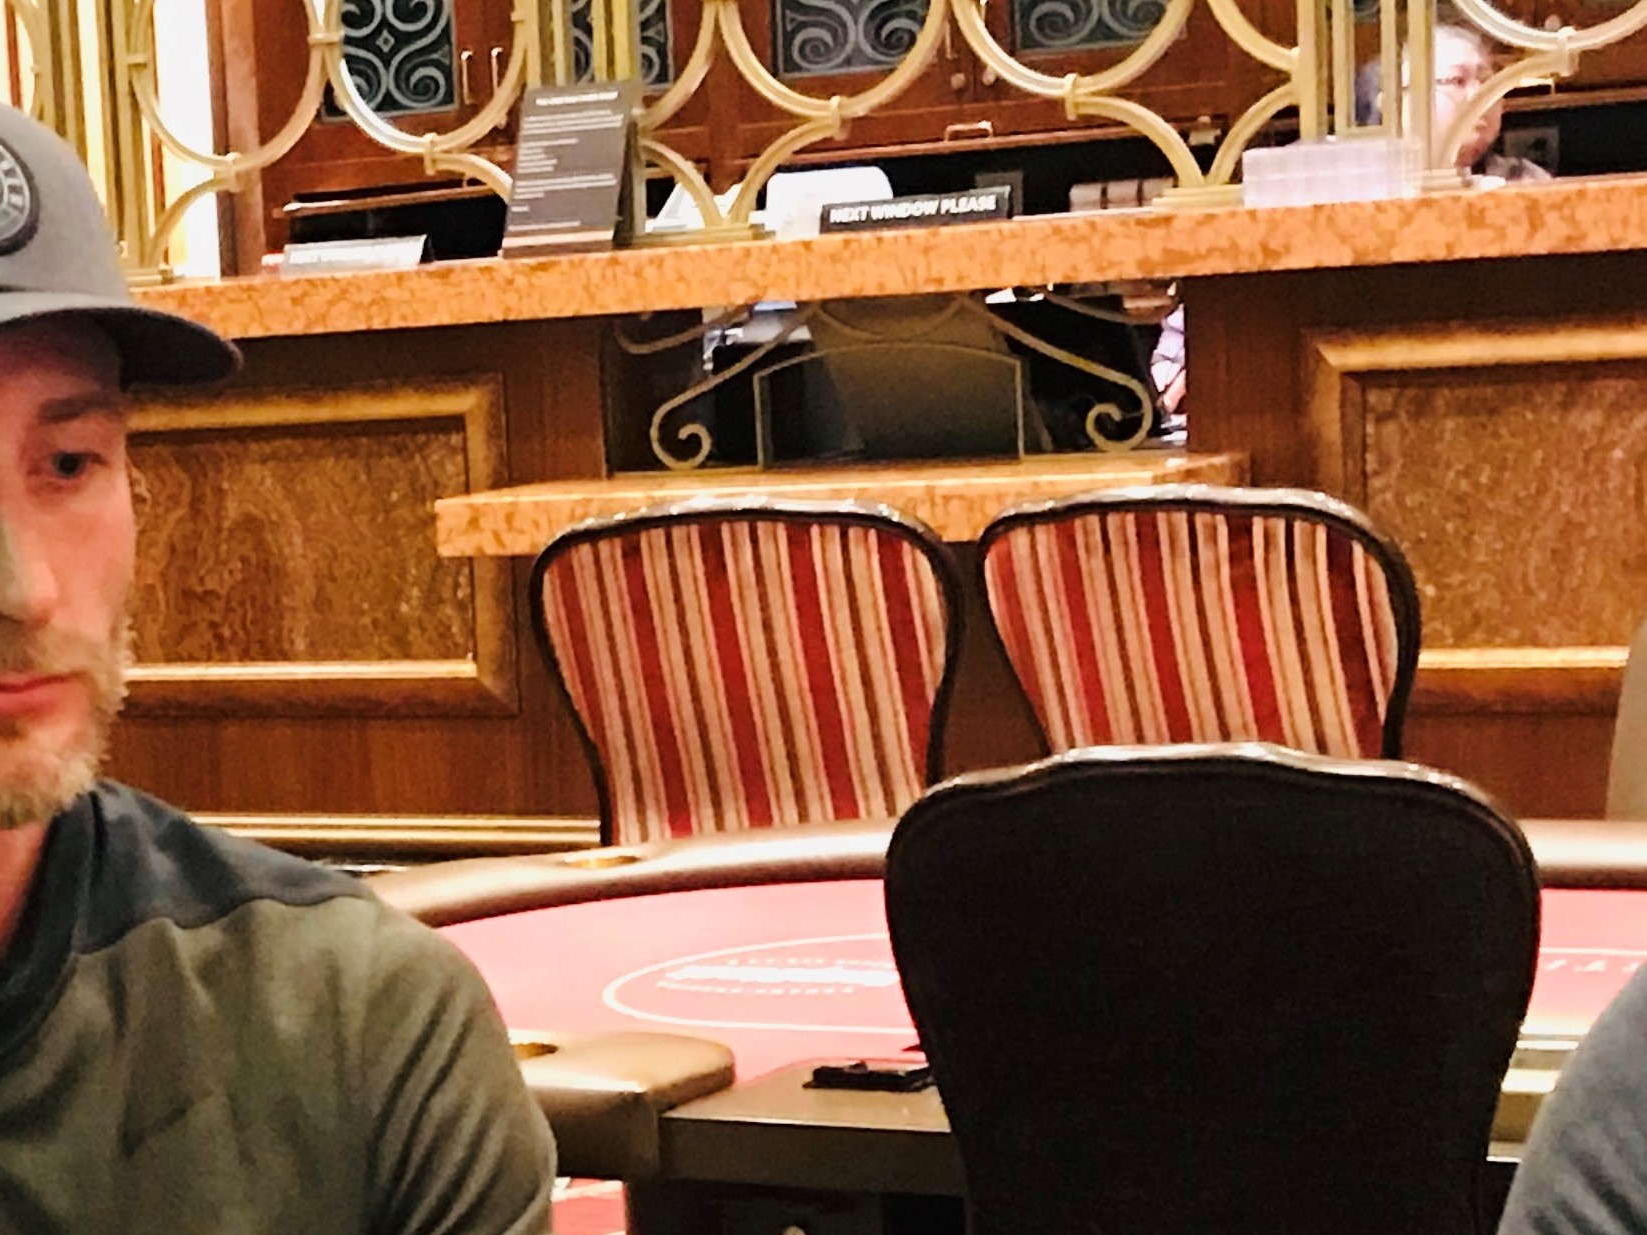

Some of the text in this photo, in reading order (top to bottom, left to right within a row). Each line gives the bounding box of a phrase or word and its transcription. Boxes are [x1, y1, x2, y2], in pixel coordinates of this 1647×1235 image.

[829, 195, 996, 223] NEXT WINDOW PLEASE
